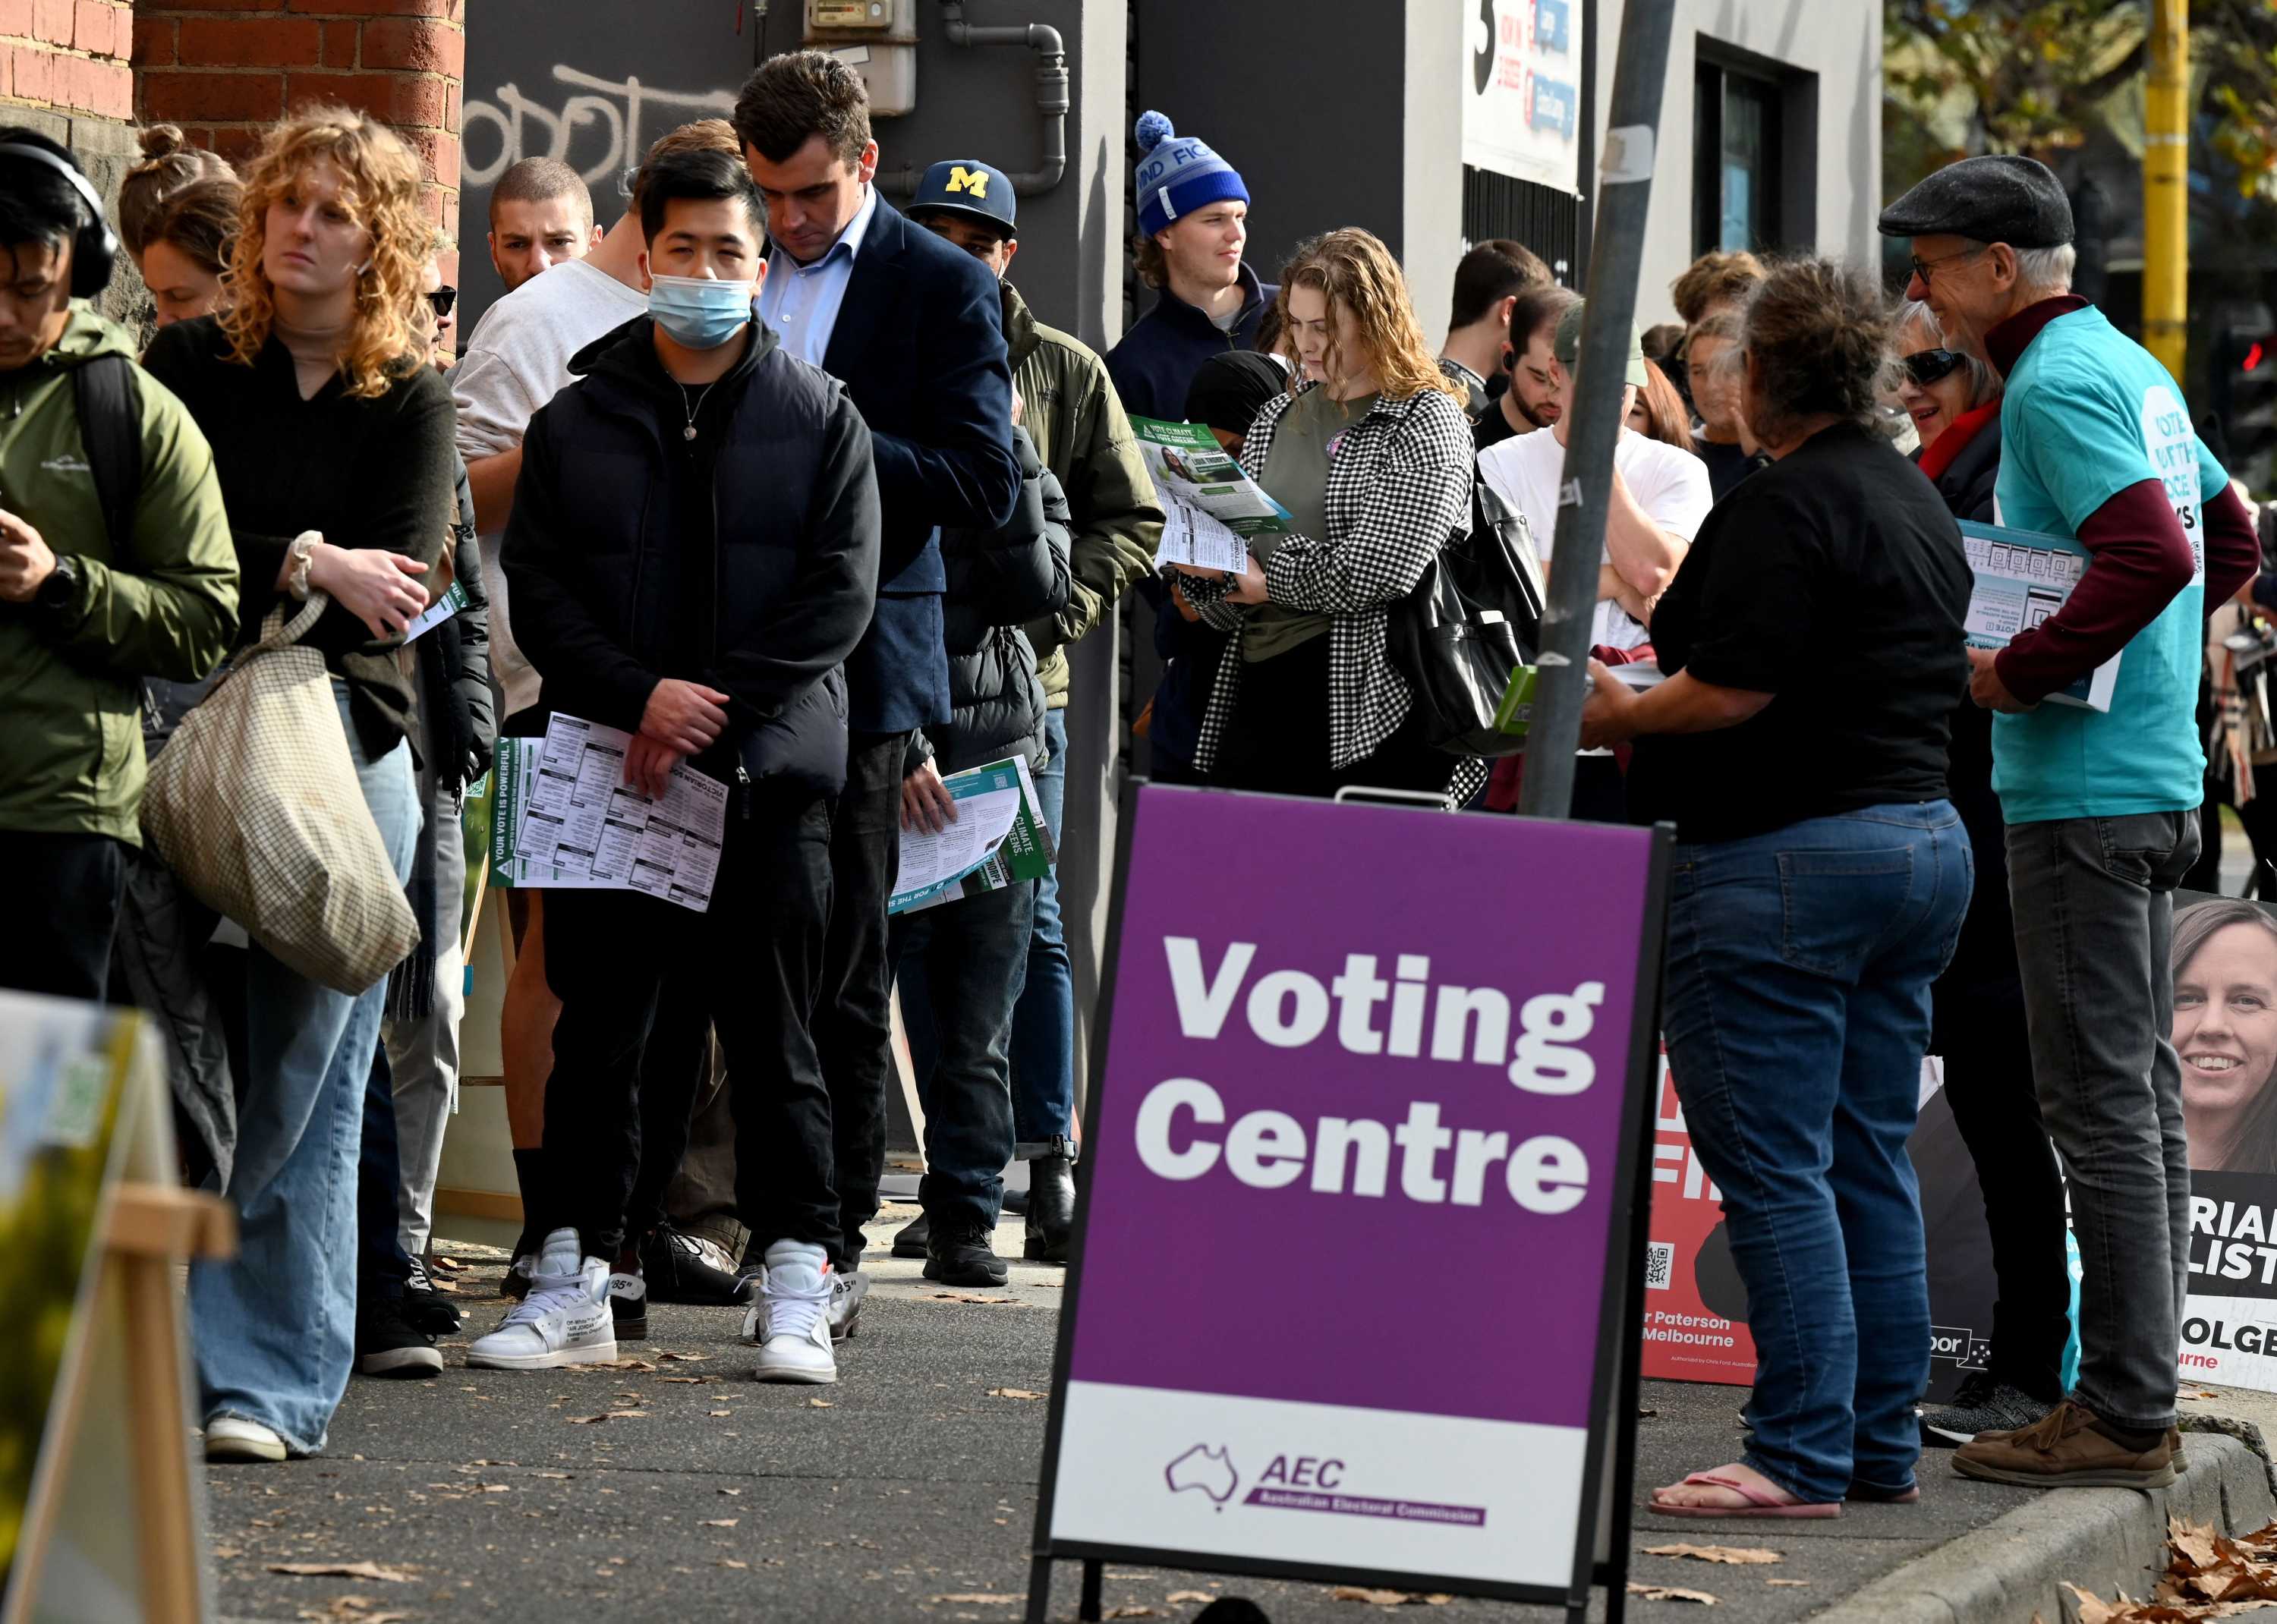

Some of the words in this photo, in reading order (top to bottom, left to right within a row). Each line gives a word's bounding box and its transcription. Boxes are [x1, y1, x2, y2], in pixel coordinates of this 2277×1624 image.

[945, 166, 989, 199] M
[499, 747, 510, 796] POWERFUL.
[499, 800, 507, 812] IS
[497, 813, 506, 836] VOTE
[1015, 817, 1034, 855] CLIMATE.
[496, 838, 505, 861] YOUR
[1163, 935, 1605, 1095] Voting
[1135, 1077, 1589, 1214] Centre
[1655, 1311, 1731, 1330] Paterson
[1642, 1327, 1734, 1348] Melbourne
[1258, 1455, 1346, 1489] AEC
[1259, 1491, 1329, 1508] Australian
[1332, 1497, 1394, 1515] Electoral
[1396, 1503, 1480, 1522] Commission
